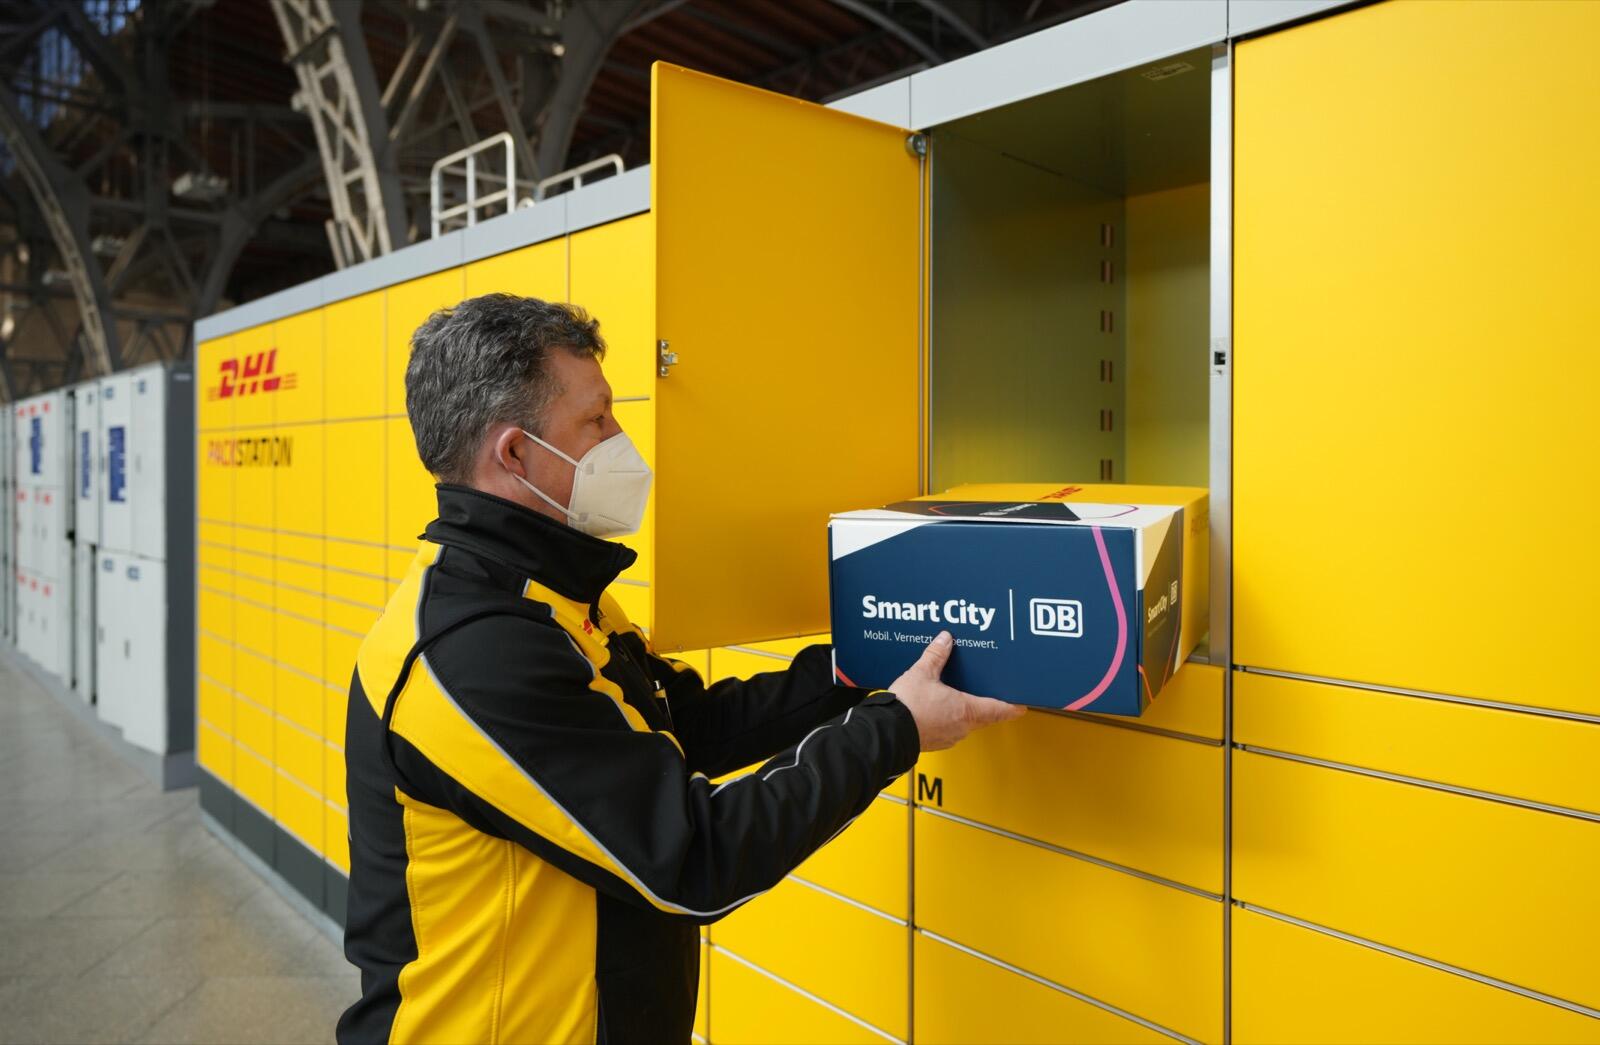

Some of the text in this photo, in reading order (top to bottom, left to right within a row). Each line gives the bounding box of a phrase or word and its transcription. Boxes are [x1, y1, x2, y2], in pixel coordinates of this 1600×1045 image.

[219, 348, 281, 399] DHL
[862, 595, 1078, 633] Smart City DB
[863, 630, 892, 641] Mobil.
[952, 638, 999, 650] enswert.
[918, 773, 943, 807] M
